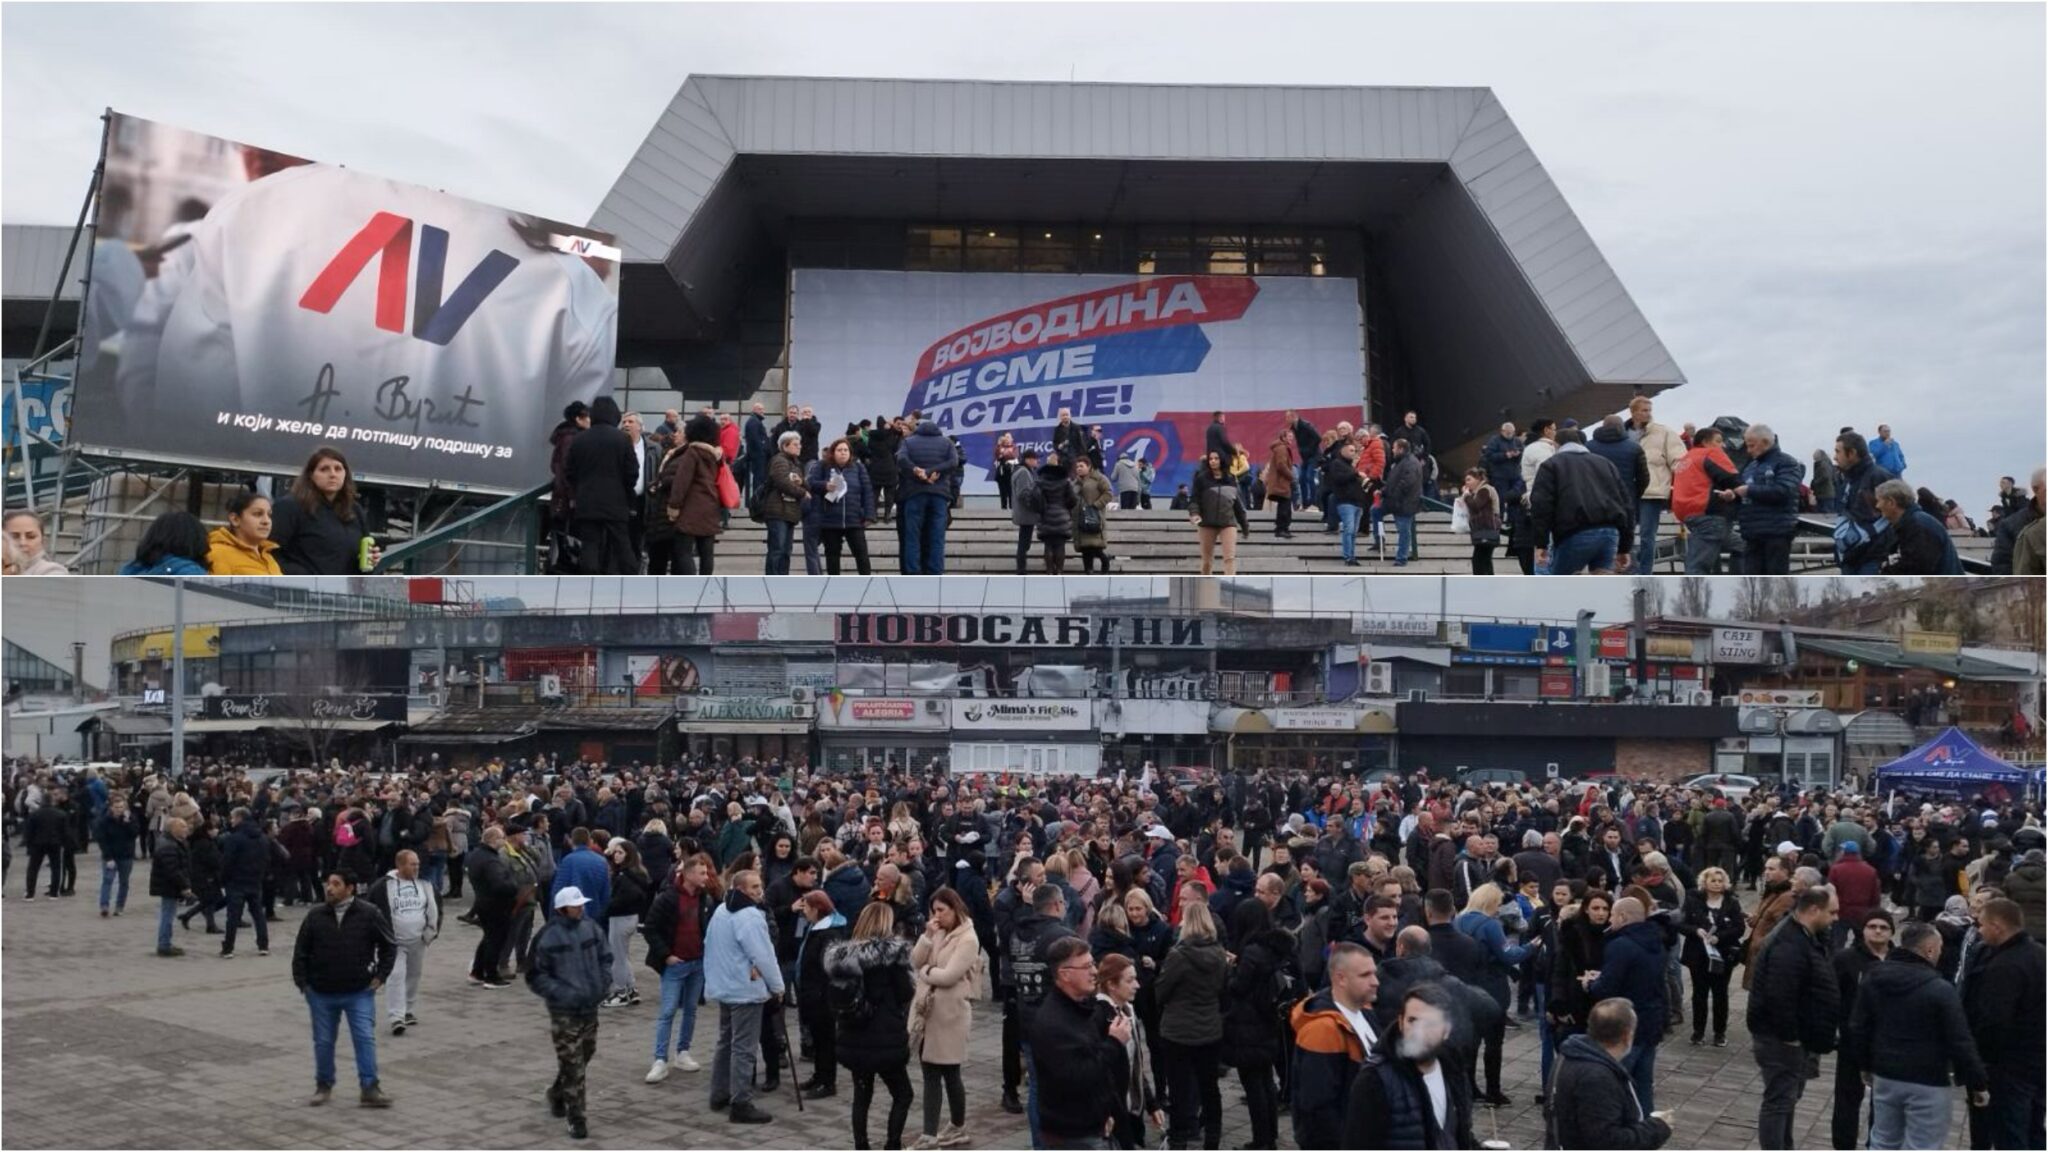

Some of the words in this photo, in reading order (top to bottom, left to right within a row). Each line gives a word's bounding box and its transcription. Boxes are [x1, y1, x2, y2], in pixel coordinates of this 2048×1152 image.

[932, 282, 1208, 373] ВОЈВОДИНА
[923, 368, 972, 406] НЕ
[975, 344, 1097, 391] СМЕ
[961, 384, 1135, 429] СТАНЕ!
[217, 411, 229, 424] и
[234, 412, 272, 433] који
[275, 418, 323, 436] желе
[325, 425, 348, 440] да
[351, 427, 423, 450] потпишу
[425, 437, 494, 459] подршку
[494, 445, 513, 459] за
[1719, 646, 1756, 658] STING
[987, 703, 1036, 717] Mima's
